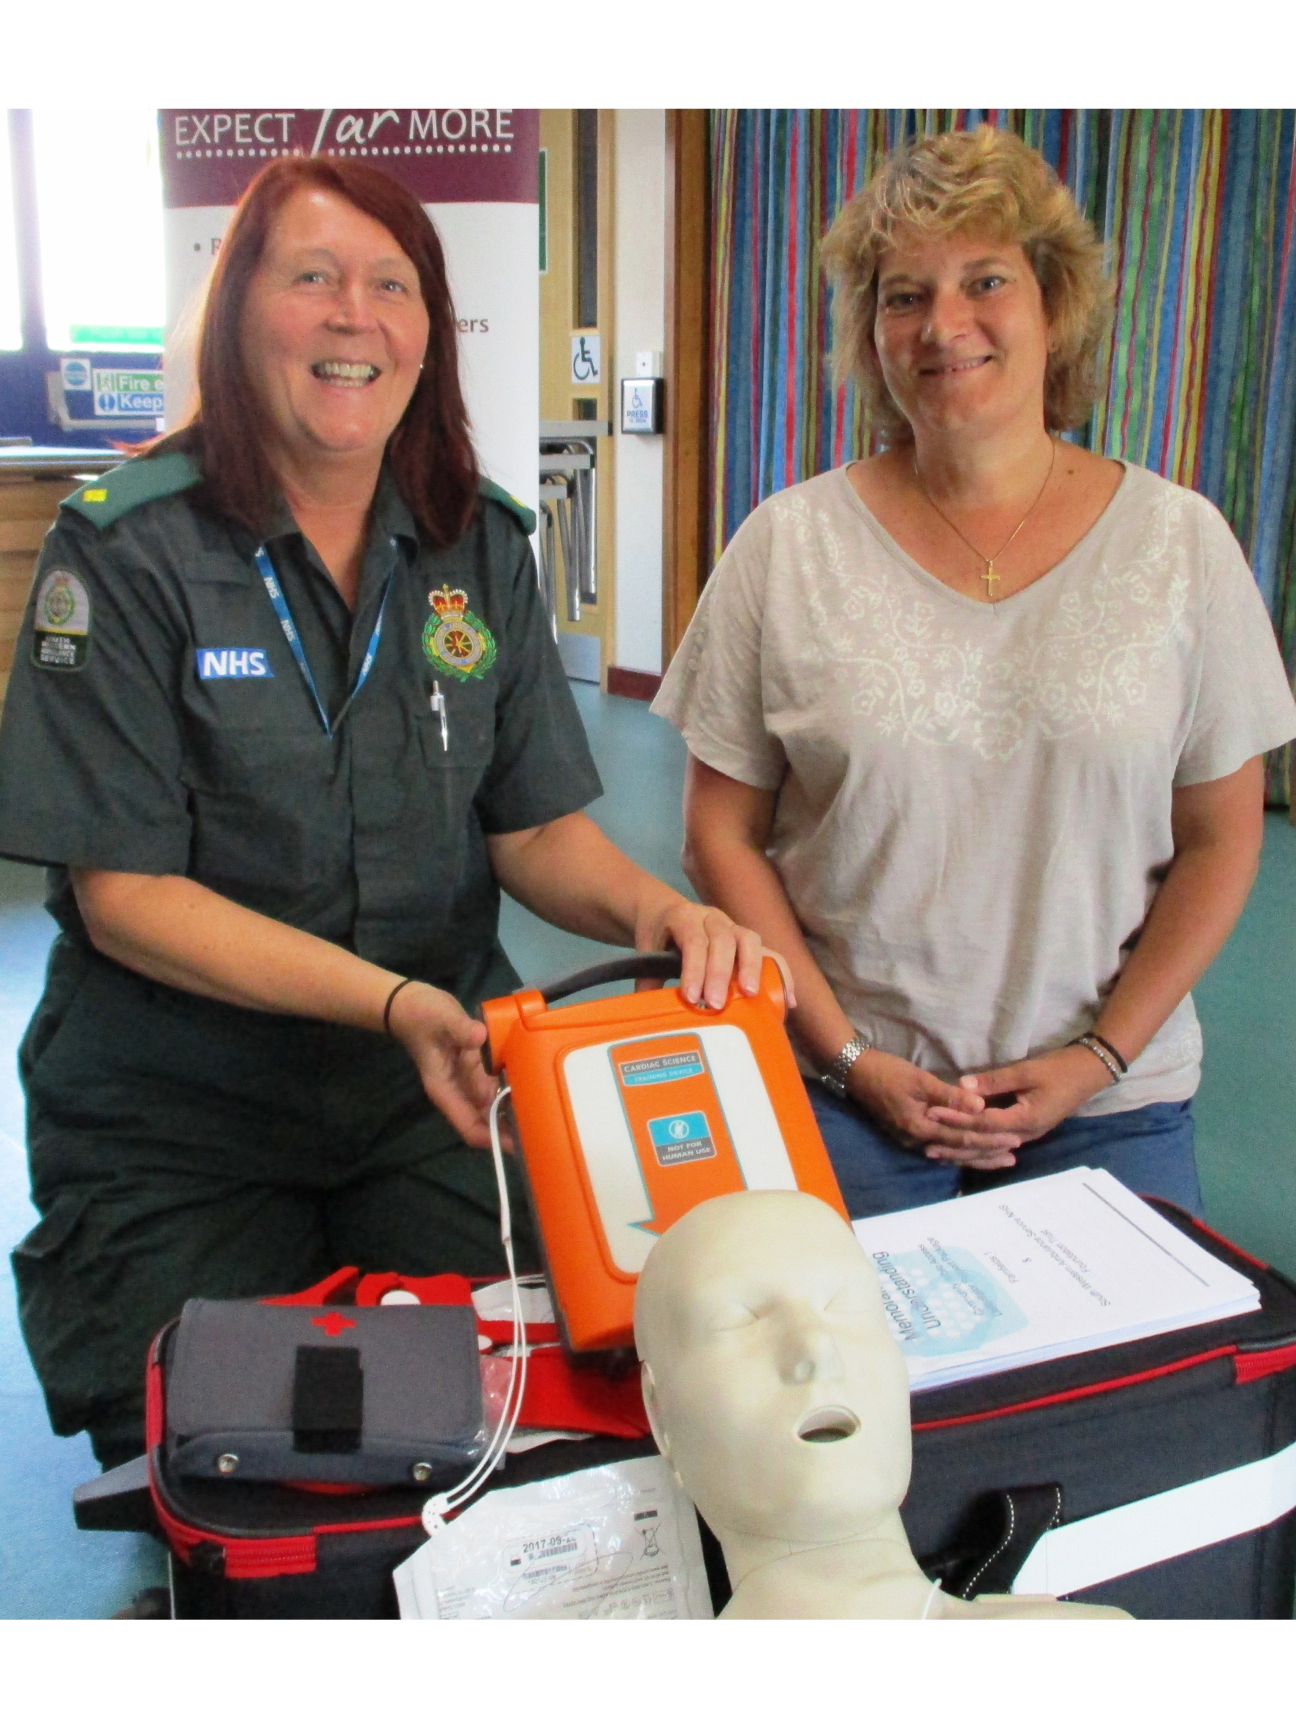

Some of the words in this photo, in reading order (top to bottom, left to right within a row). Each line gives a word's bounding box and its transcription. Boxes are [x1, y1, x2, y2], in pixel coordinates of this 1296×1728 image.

[175, 112, 296, 146] EXPECT
[408, 109, 514, 140] MORE
[119, 375, 150, 391] Fire
[119, 394, 163, 412] Keep
[626, 410, 648, 418] PRESS
[263, 576, 281, 599] NHS
[281, 619, 296, 643] NHS
[203, 651, 267, 677] NHS
[623, 1061, 661, 1073] CARDIAC
[662, 1055, 697, 1066] SCIENCE
[662, 1150, 695, 1161] HUMAN
[667, 1144, 685, 1153] NOT
[685, 1140, 703, 1149] FOR
